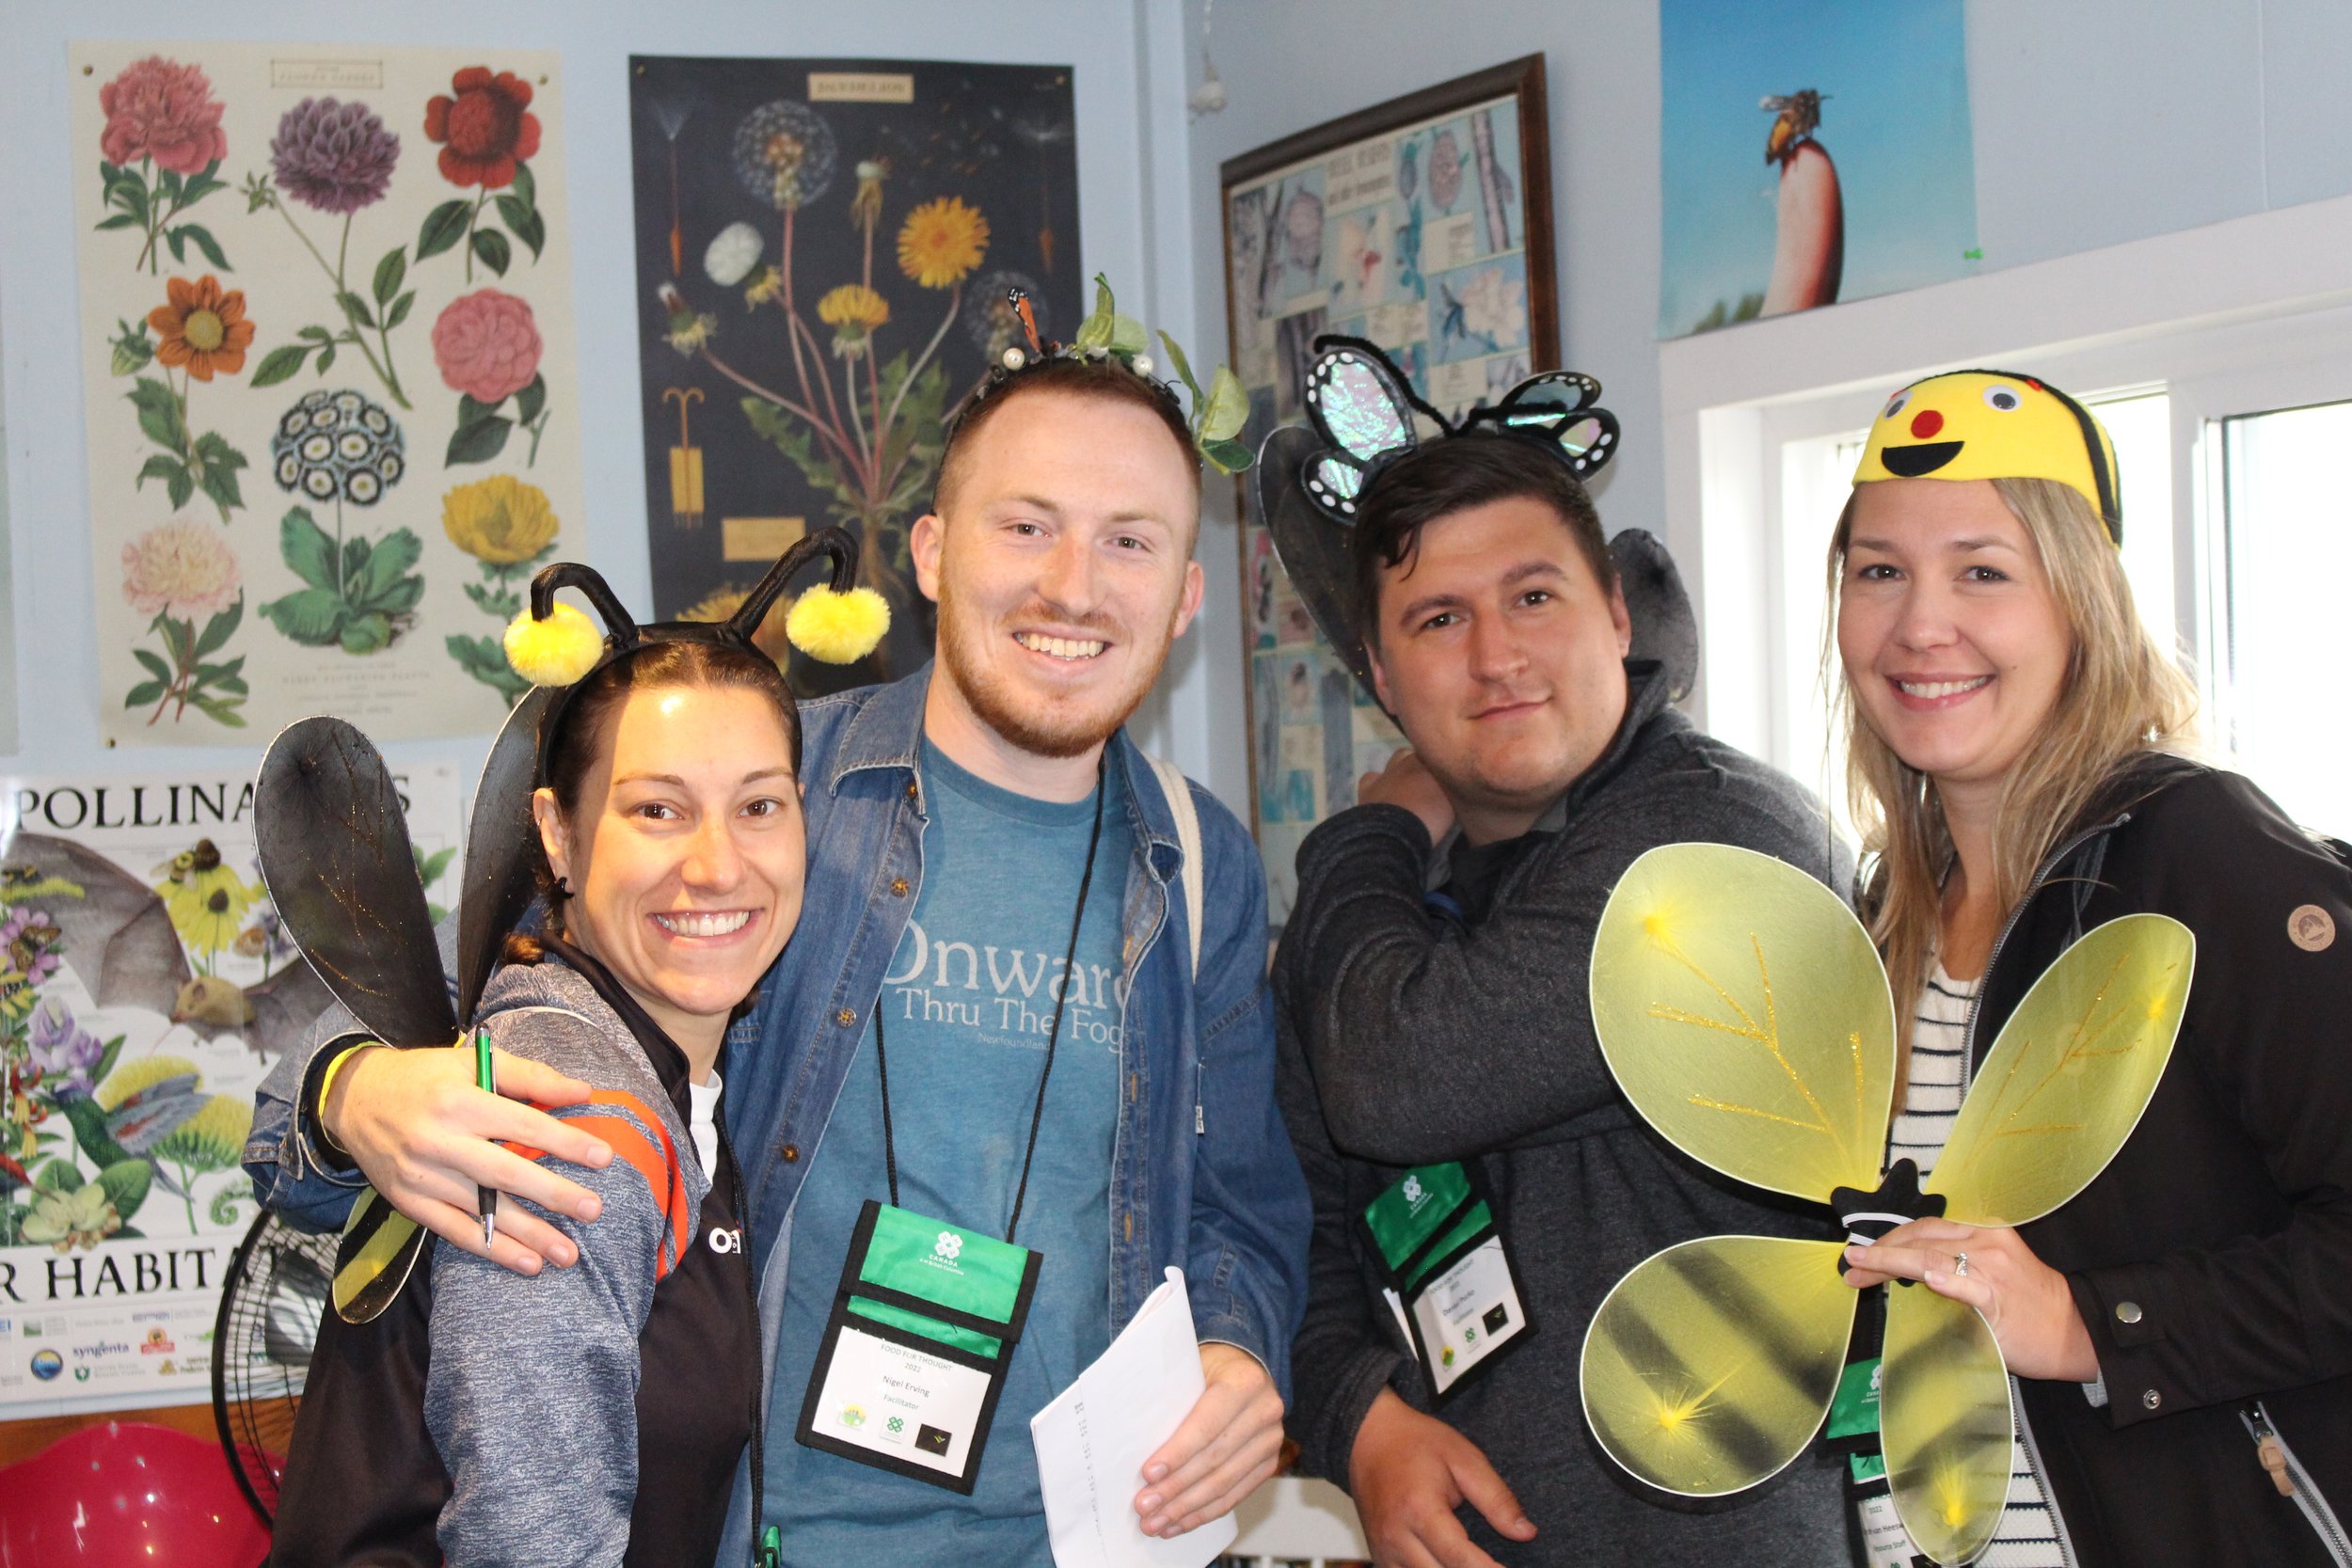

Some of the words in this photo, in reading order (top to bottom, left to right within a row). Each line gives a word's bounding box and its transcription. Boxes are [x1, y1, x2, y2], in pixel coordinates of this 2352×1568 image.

[896, 987, 981, 1027] Thru
[993, 997, 1057, 1036] The
[1070, 1007, 1123, 1054] Fog
[929, 1253, 958, 1268] CANADA
[72, 1340, 130, 1360] syngenta
[881, 1344, 902, 1355] FOOD
[902, 1350, 917, 1361] FOR
[918, 1355, 953, 1371] THOUGHT
[904, 1362, 922, 1373] 2022
[882, 1375, 904, 1388] Nigel
[905, 1382, 930, 1398] Erving
[883, 1394, 919, 1410] Facilitator
